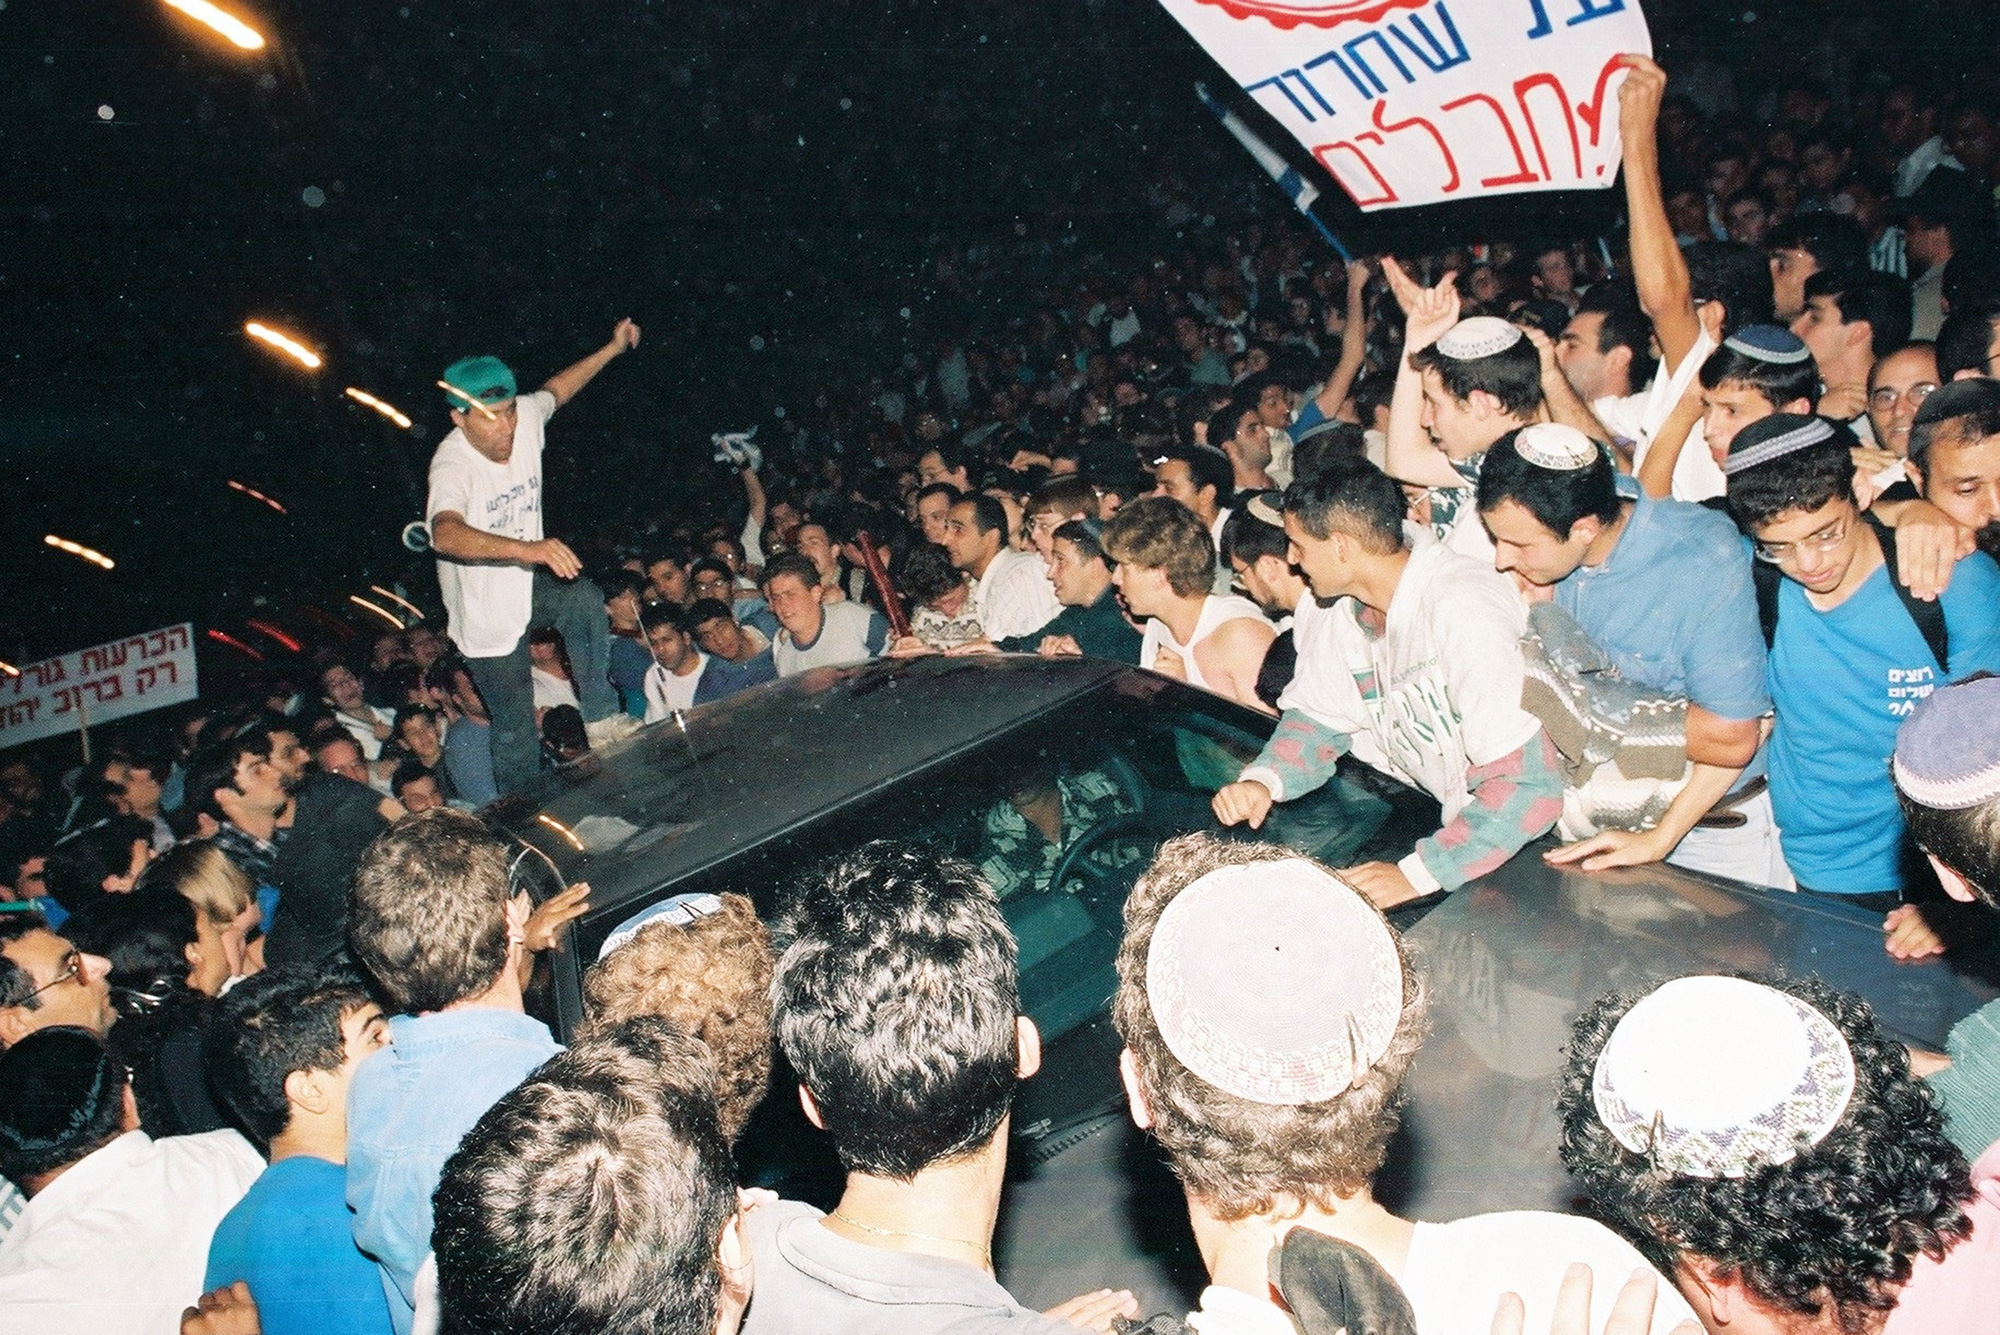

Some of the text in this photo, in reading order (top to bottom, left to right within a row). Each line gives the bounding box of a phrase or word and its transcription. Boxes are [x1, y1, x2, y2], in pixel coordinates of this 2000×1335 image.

[1243, 1, 1471, 123] שחרור
[80, 625, 188, 677] הכרעות
[136, 660, 178, 696] רק
[1888, 666, 1934, 682] רוצים
[1888, 684, 1934, 698] שלום
[53, 673, 124, 715] ברוב
